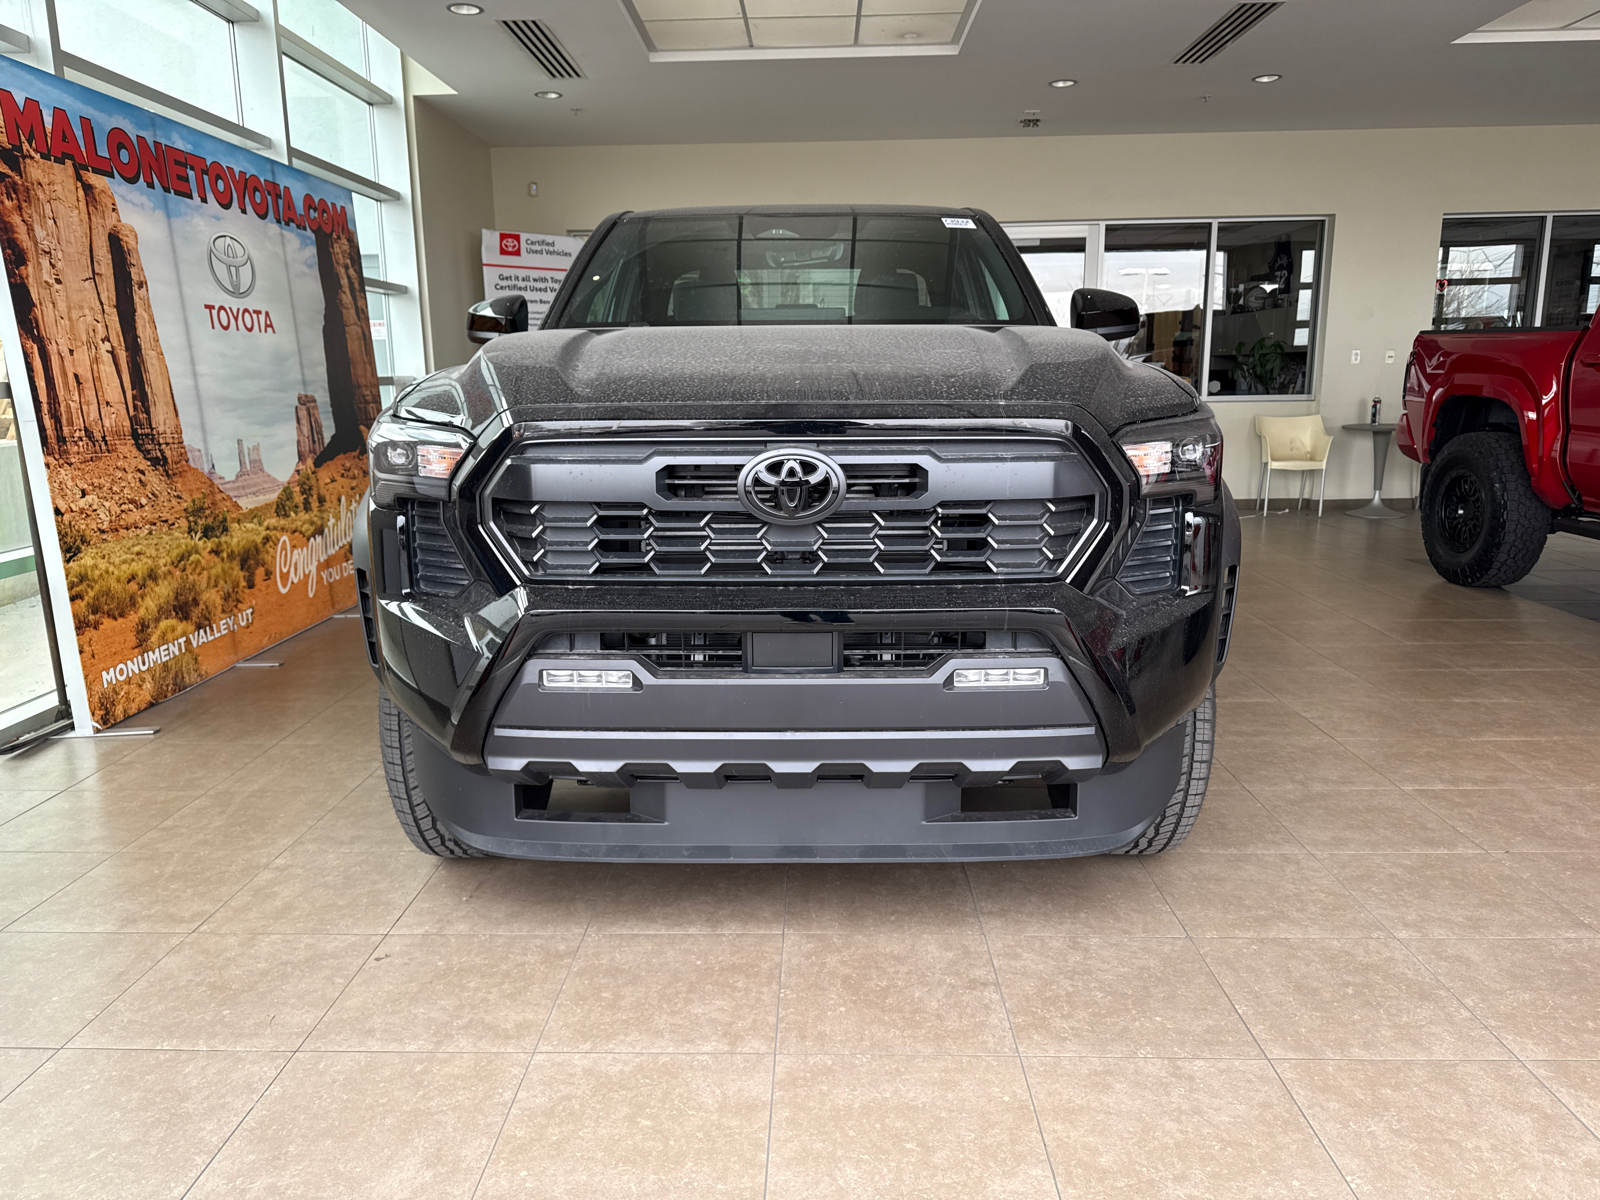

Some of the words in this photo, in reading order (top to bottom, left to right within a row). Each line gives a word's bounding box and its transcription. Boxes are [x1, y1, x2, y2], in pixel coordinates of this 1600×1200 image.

[0, 88, 350, 239] MALONETOYOTA.COM
[525, 238, 555, 247] Certified
[526, 247, 544, 255] Used
[545, 248, 572, 257] Vehicles
[498, 273, 513, 282] Get
[514, 273, 520, 282] it
[521, 274, 531, 283] all
[532, 275, 549, 284] with
[494, 283, 528, 292] Certified
[529, 284, 547, 293] Used
[204, 303, 276, 334] TOYOTA
[321, 564, 341, 585] YOU
[101, 636, 187, 689] MONUMENT
[189, 615, 238, 649] VALLEY,
[238, 608, 254, 627] UT
